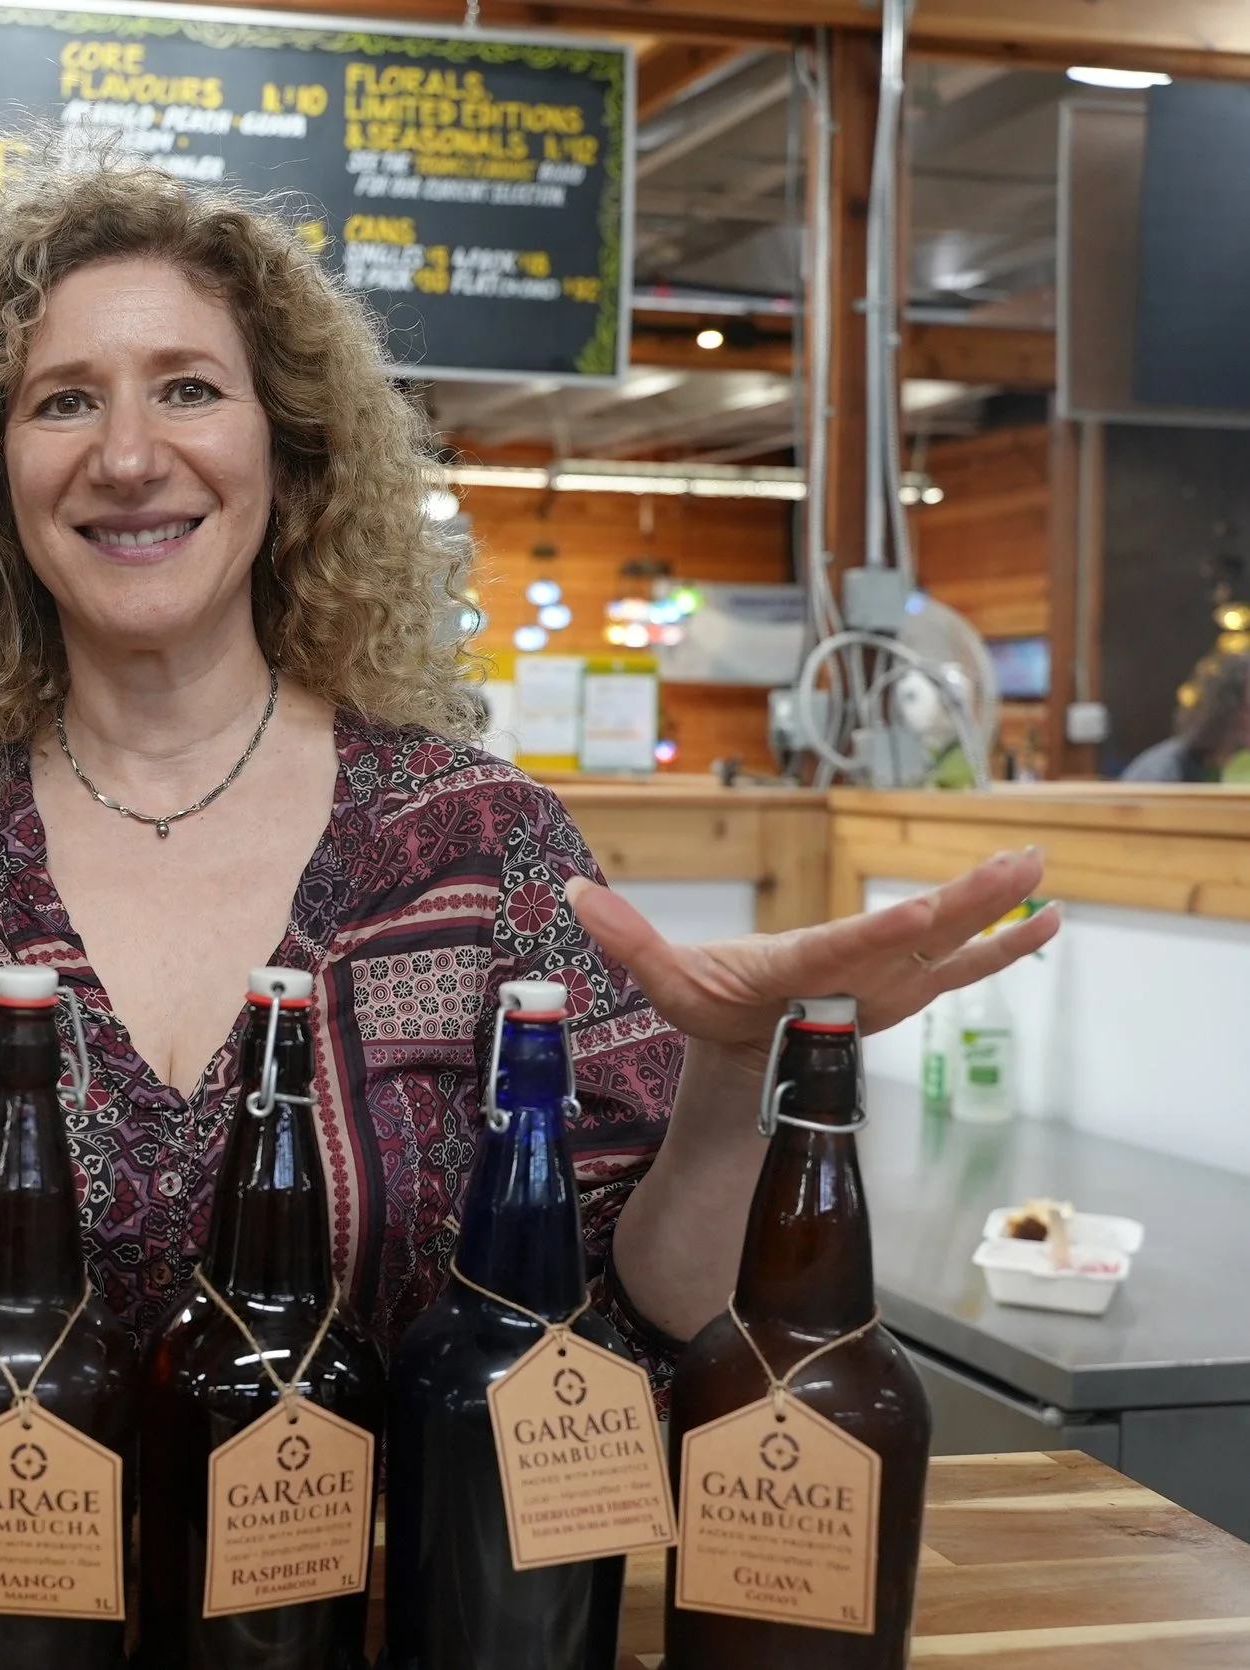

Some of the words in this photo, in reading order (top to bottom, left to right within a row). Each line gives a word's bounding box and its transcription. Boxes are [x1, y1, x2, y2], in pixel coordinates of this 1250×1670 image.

[60, 40, 146, 75] CORE
[60, 68, 224, 110] FLAVOURS
[344, 95, 459, 125] LIMITED
[461, 99, 585, 134] EDITIONS
[514, 1406, 641, 1445] GARAGE
[518, 1440, 646, 1470] KOMBUCHA
[227, 1470, 355, 1508] GARAGE
[701, 1471, 855, 1514] GARAGE
[226, 1501, 353, 1531] KOMBUCHA
[652, 1523, 668, 1537] 1L
[701, 1503, 853, 1538] KOMBUCHA
[231, 1555, 344, 1586] RASPBERRY
[341, 1574, 355, 1587] 1L
[733, 1566, 815, 1595] GUAVA
[95, 1597, 114, 1611] 1L
[841, 1605, 860, 1620] 1L
